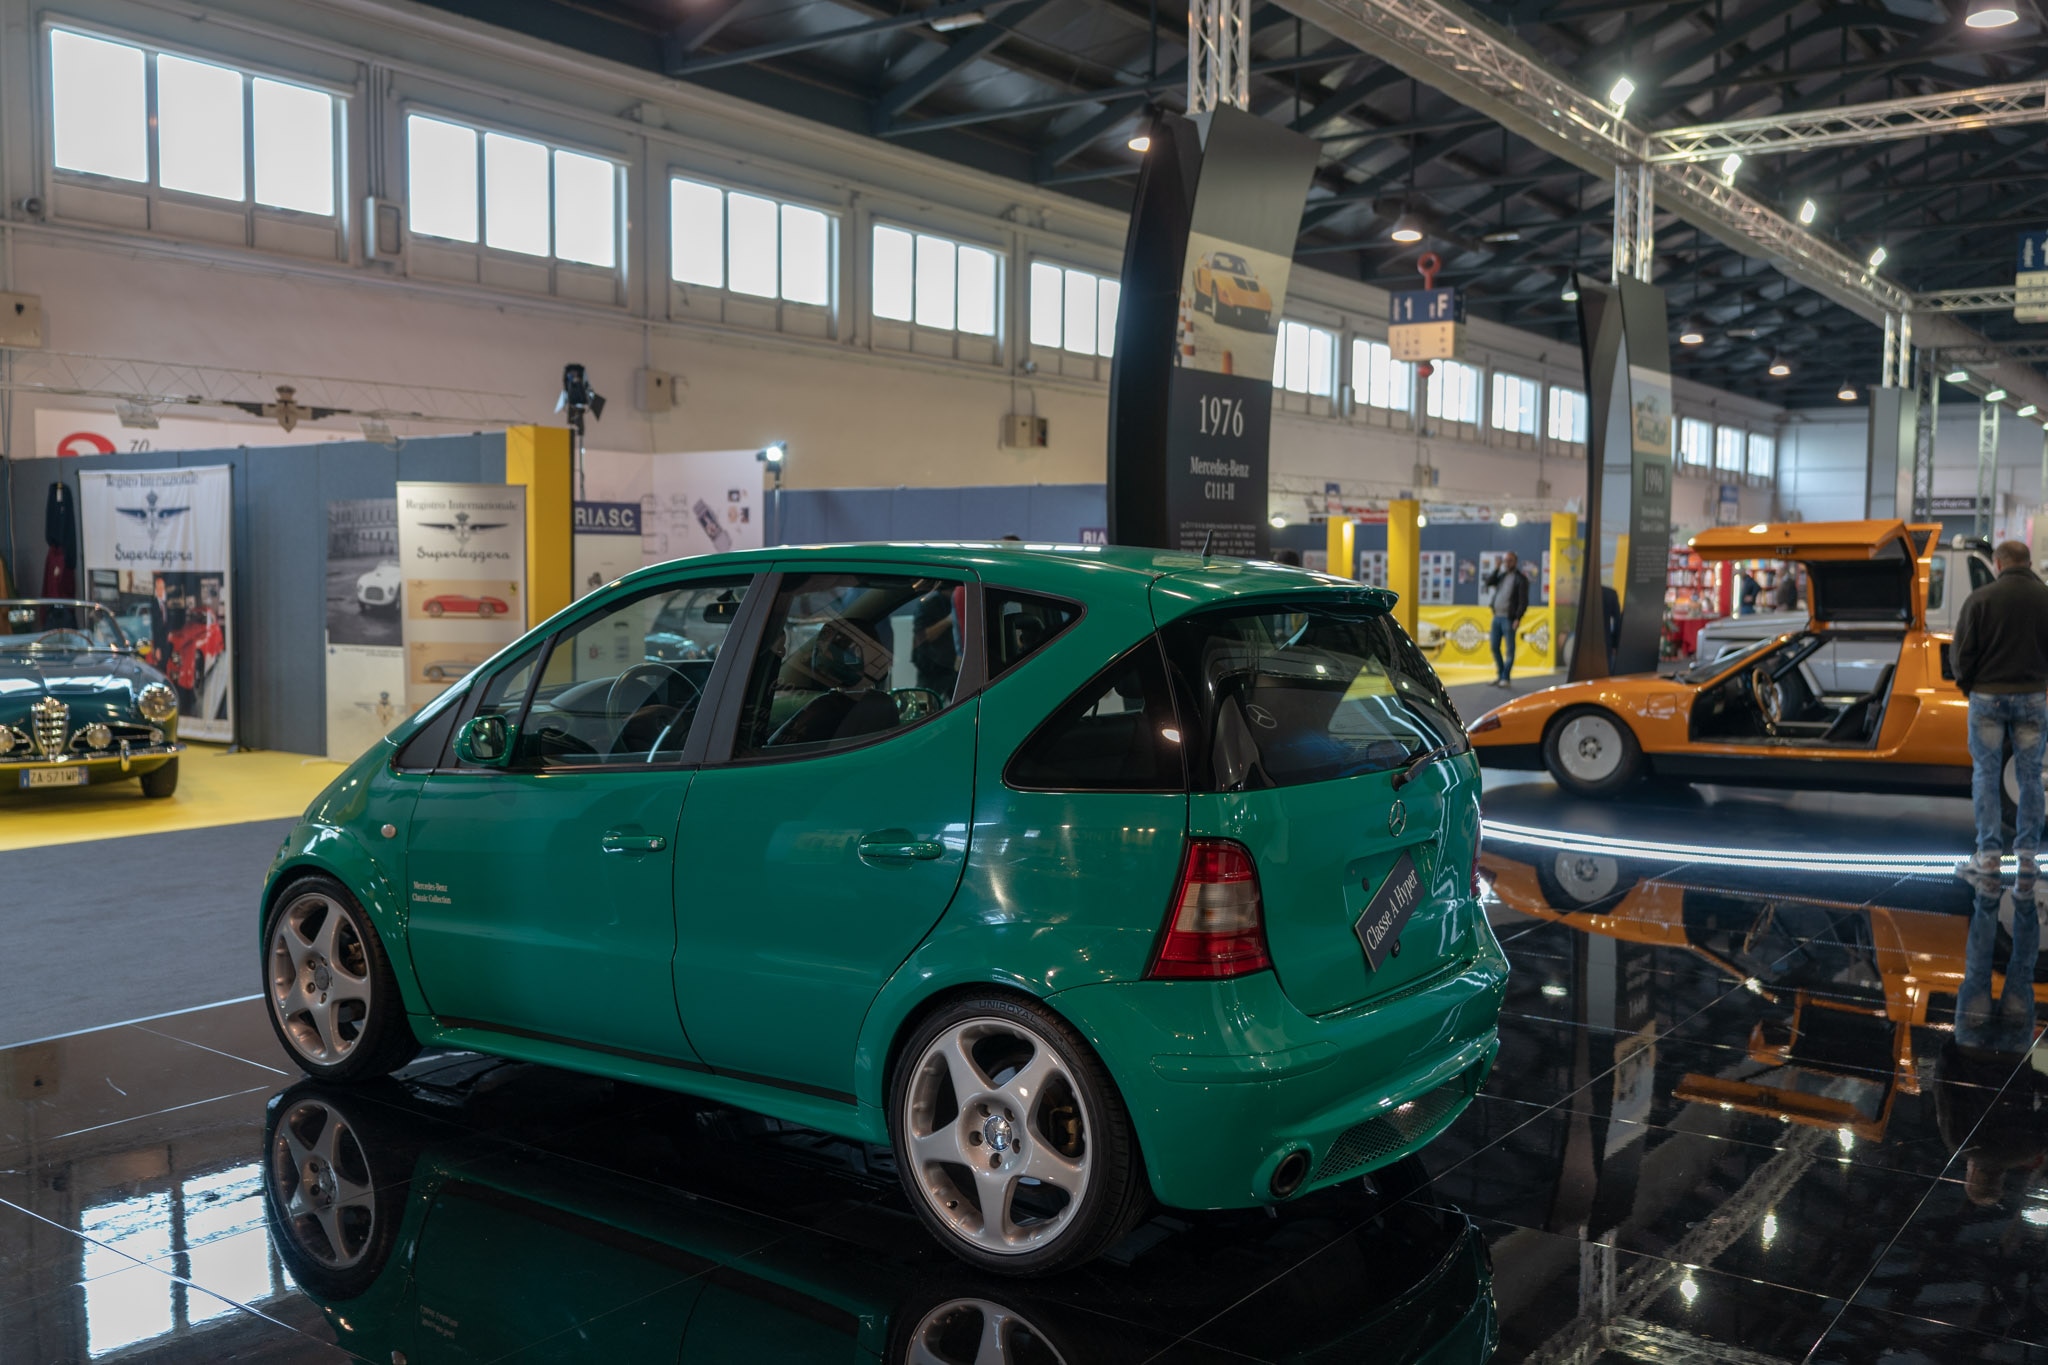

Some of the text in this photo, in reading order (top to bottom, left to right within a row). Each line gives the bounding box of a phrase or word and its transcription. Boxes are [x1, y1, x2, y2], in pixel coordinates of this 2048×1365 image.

[1404, 297, 1413, 320] 1
[1437, 293, 1449, 318] F
[1199, 394, 1244, 438] 1976
[1190, 455, 1250, 479] Mercedes-Benz
[1204, 481, 1235, 500] C111-II
[406, 499, 519, 511] Registro Internazionale
[574, 507, 634, 527] RIASC
[115, 543, 192, 567] Superleggera
[416, 546, 511, 563] Superleggera
[413, 881, 448, 891] Mercedes-Benz
[412, 893, 452, 904] Classic Collection
[1366, 869, 1418, 950] Classe A Hyper
[979, 1000, 1035, 1022] UNIROYAL
